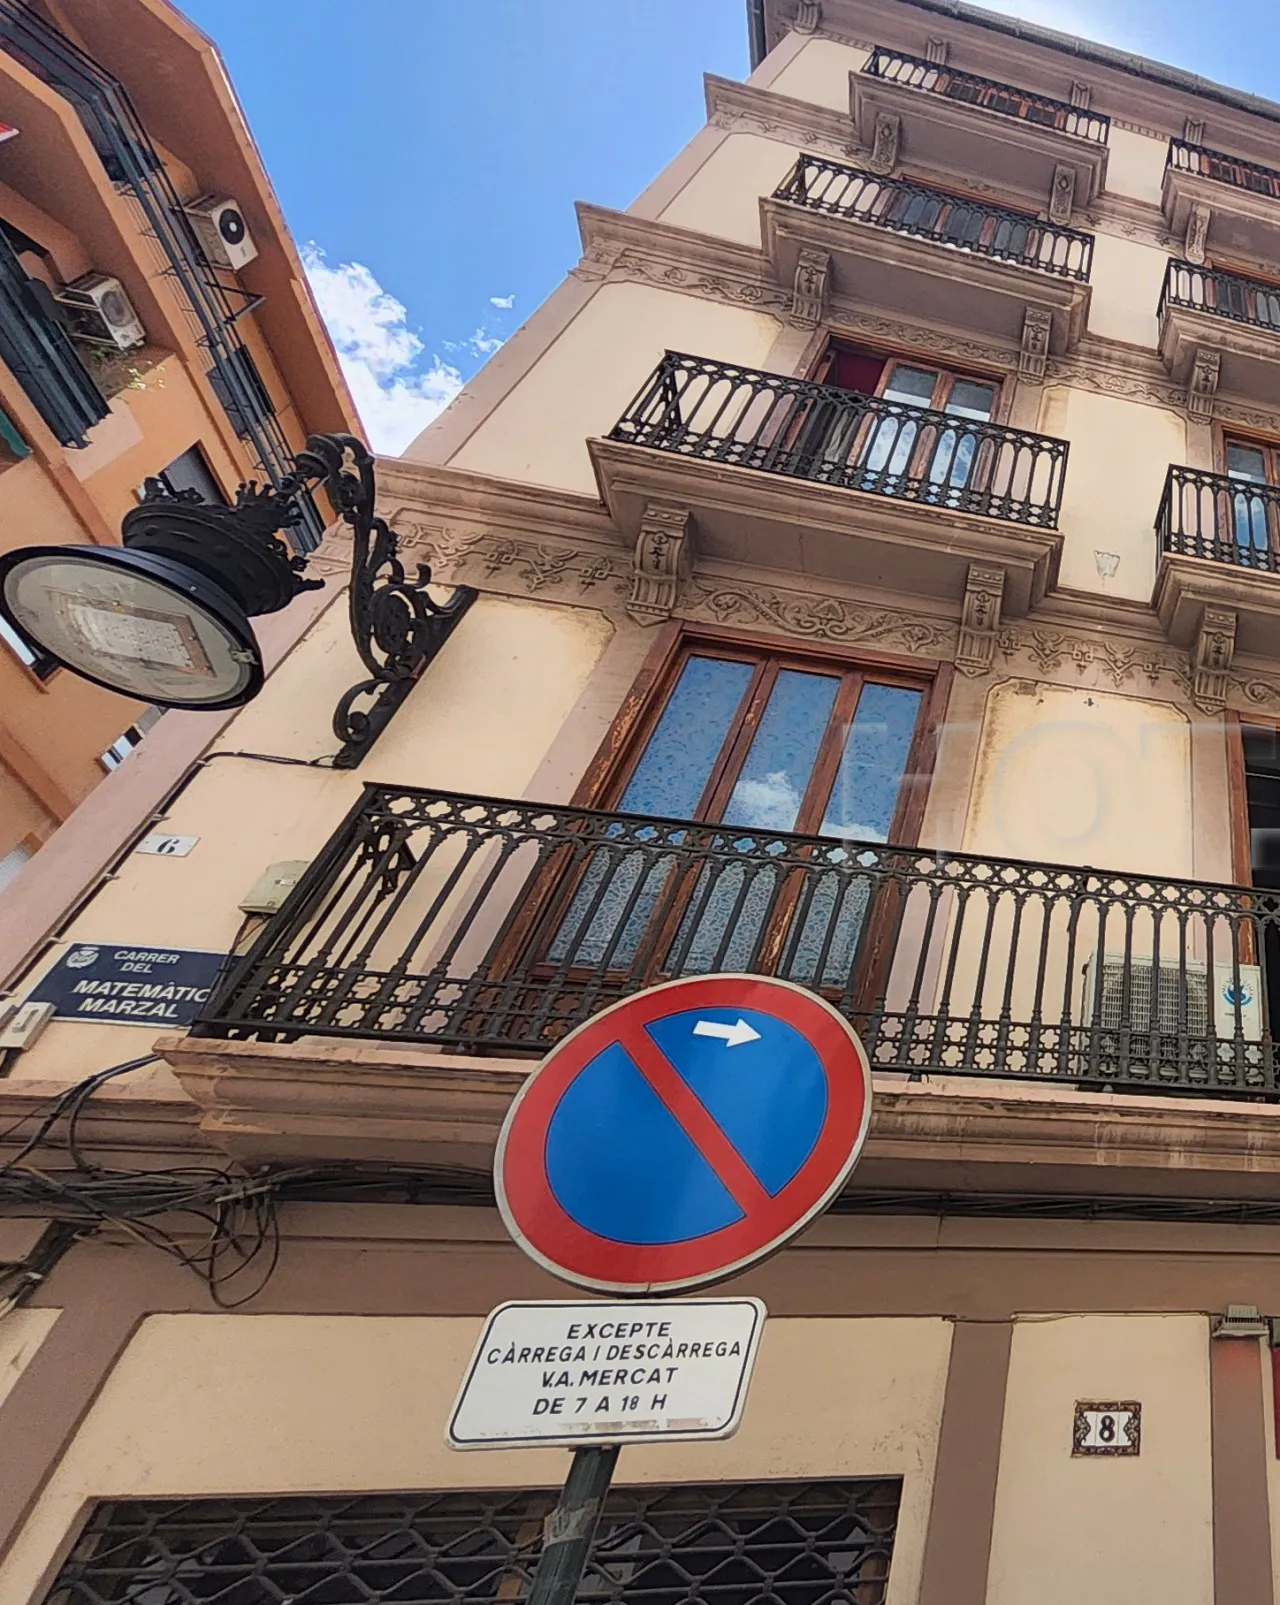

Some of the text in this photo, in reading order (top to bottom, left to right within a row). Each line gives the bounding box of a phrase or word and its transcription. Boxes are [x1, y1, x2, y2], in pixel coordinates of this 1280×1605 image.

[157, 838, 180, 854] 6
[114, 950, 180, 964] CARRER
[120, 962, 153, 973] DEL
[73, 980, 211, 1002] MATEMÀTIC
[77, 998, 179, 1018] MARZAL
[567, 1321, 672, 1340] EXCEPTE
[487, 1338, 742, 1364] CÀRREGA I DESCÀRREGA
[532, 1393, 667, 1415] DE 7 A 18 H
[1099, 1414, 1116, 1443] 8
